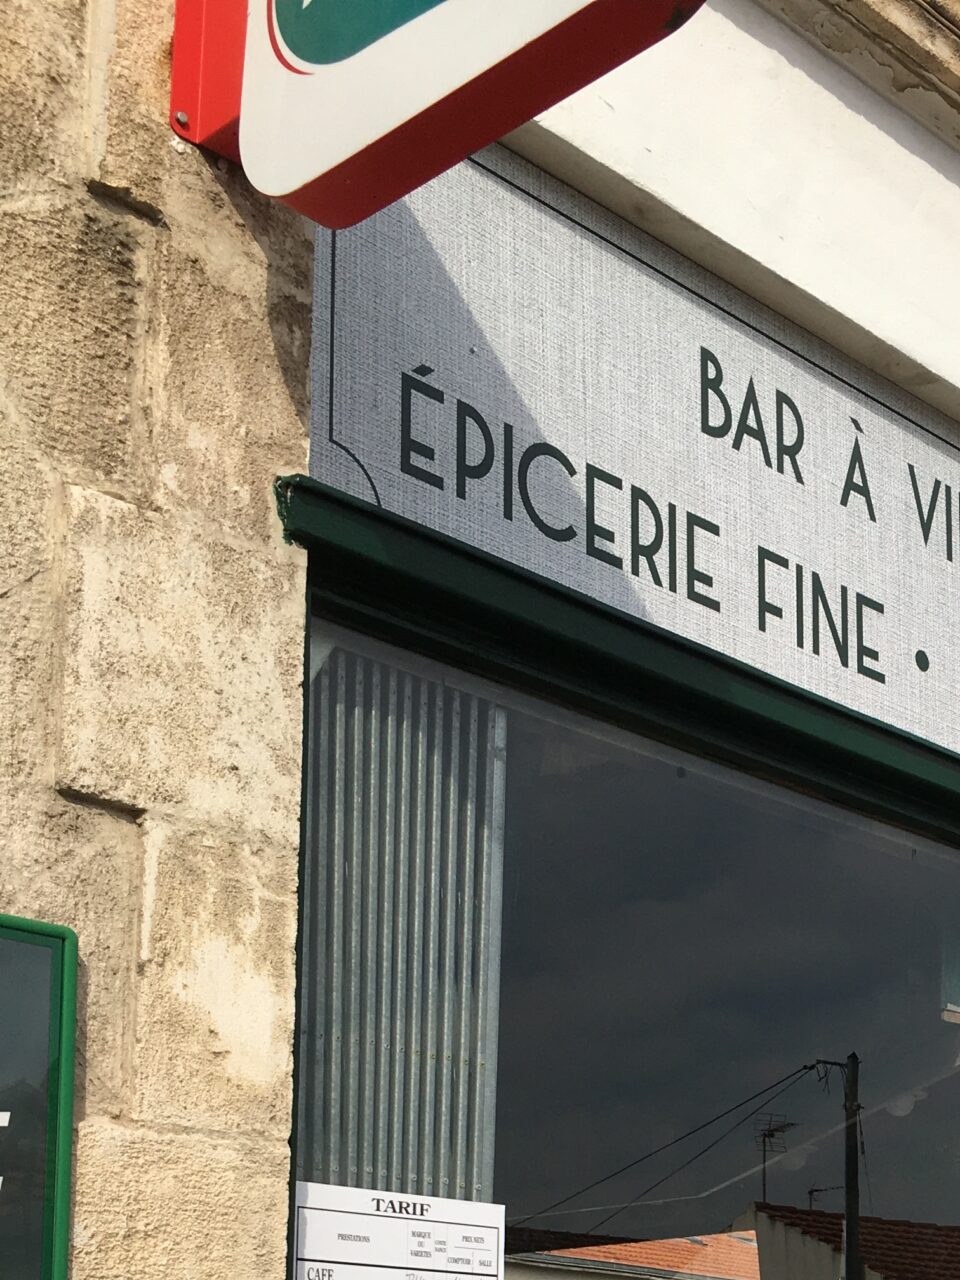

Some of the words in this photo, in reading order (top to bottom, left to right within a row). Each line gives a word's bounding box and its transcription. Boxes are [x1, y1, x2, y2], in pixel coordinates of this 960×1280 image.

[700, 345, 804, 485] BAR
[839, 415, 877, 523] À
[400, 364, 721, 613] ÉPICERIE
[757, 545, 887, 684] FINE
[337, 1233, 370, 1243] PRESTATIONS
[371, 1197, 431, 1217] TARIF
